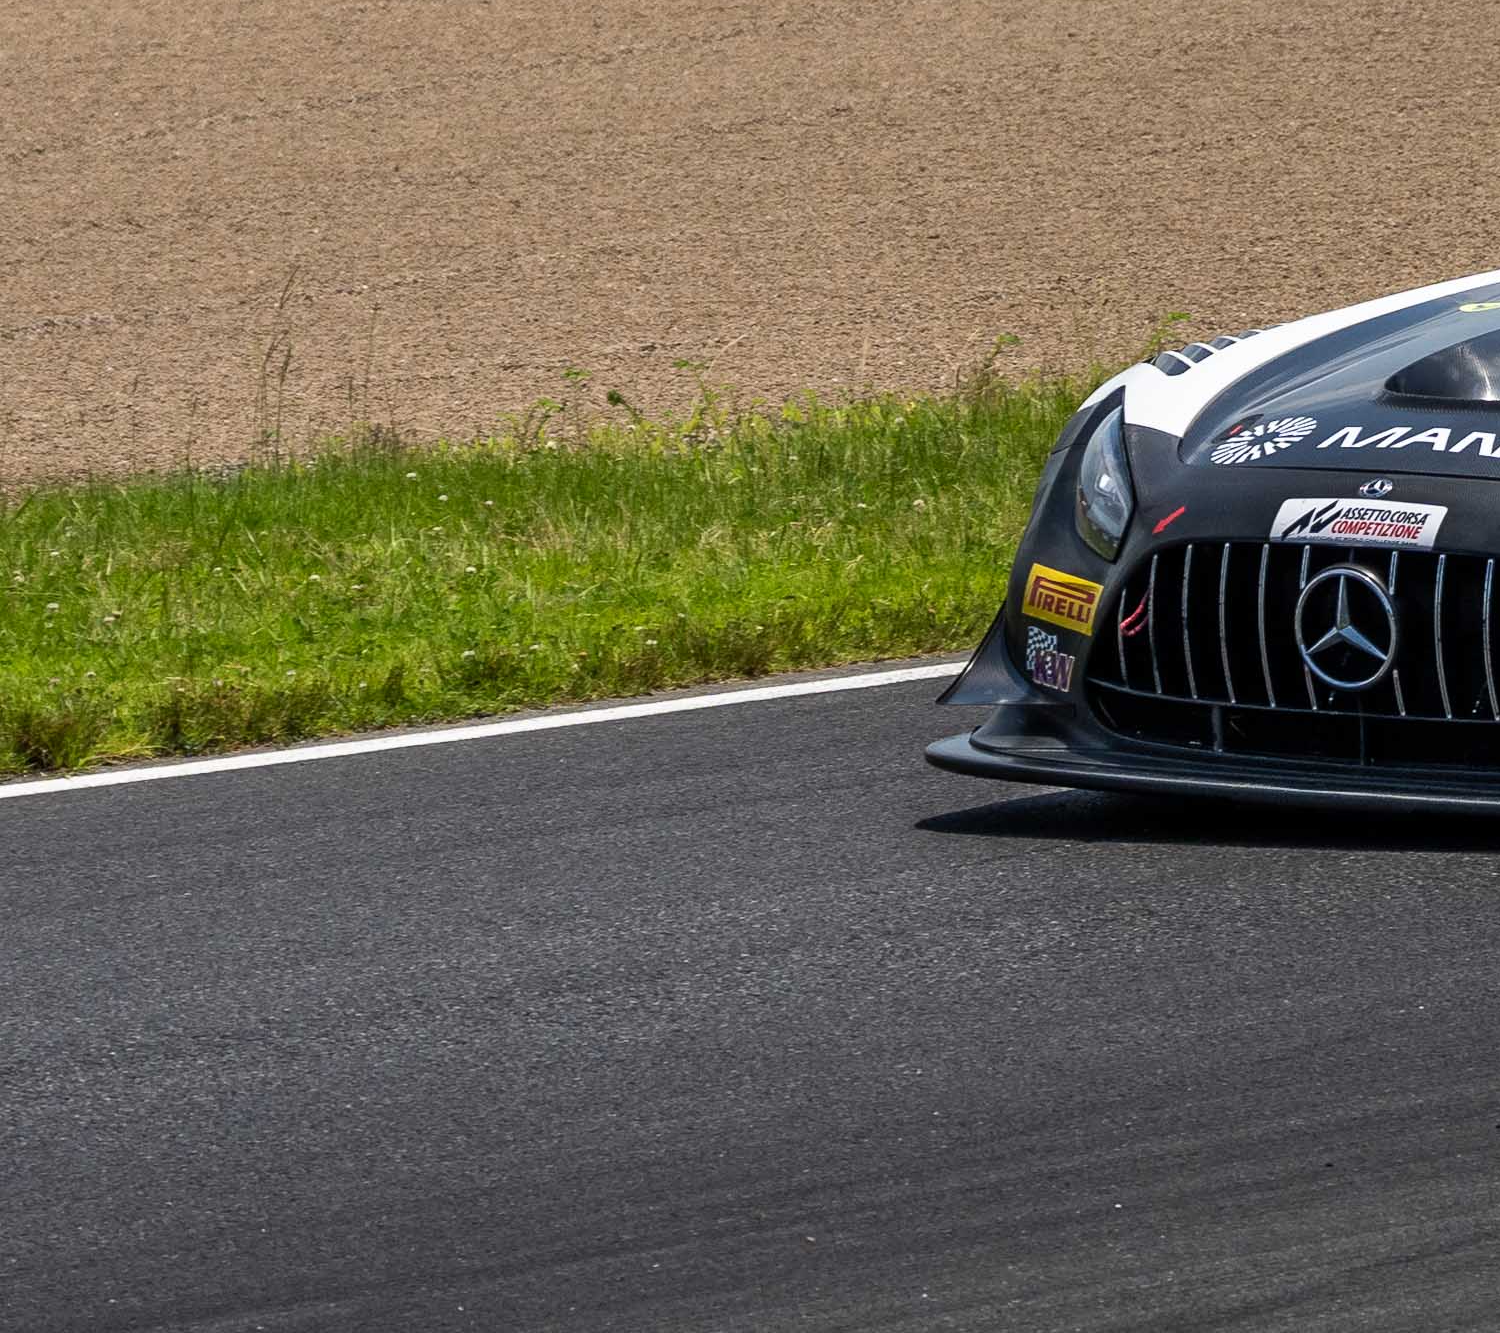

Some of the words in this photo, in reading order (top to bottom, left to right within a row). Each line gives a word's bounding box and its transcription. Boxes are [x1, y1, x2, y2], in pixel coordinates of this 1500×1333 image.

[1341, 507, 1392, 522] ASSETTO
[1390, 510, 1431, 526] CORSA
[1330, 520, 1424, 540] COMPETIZIONE
[1028, 575, 1097, 624] PIRELLI
